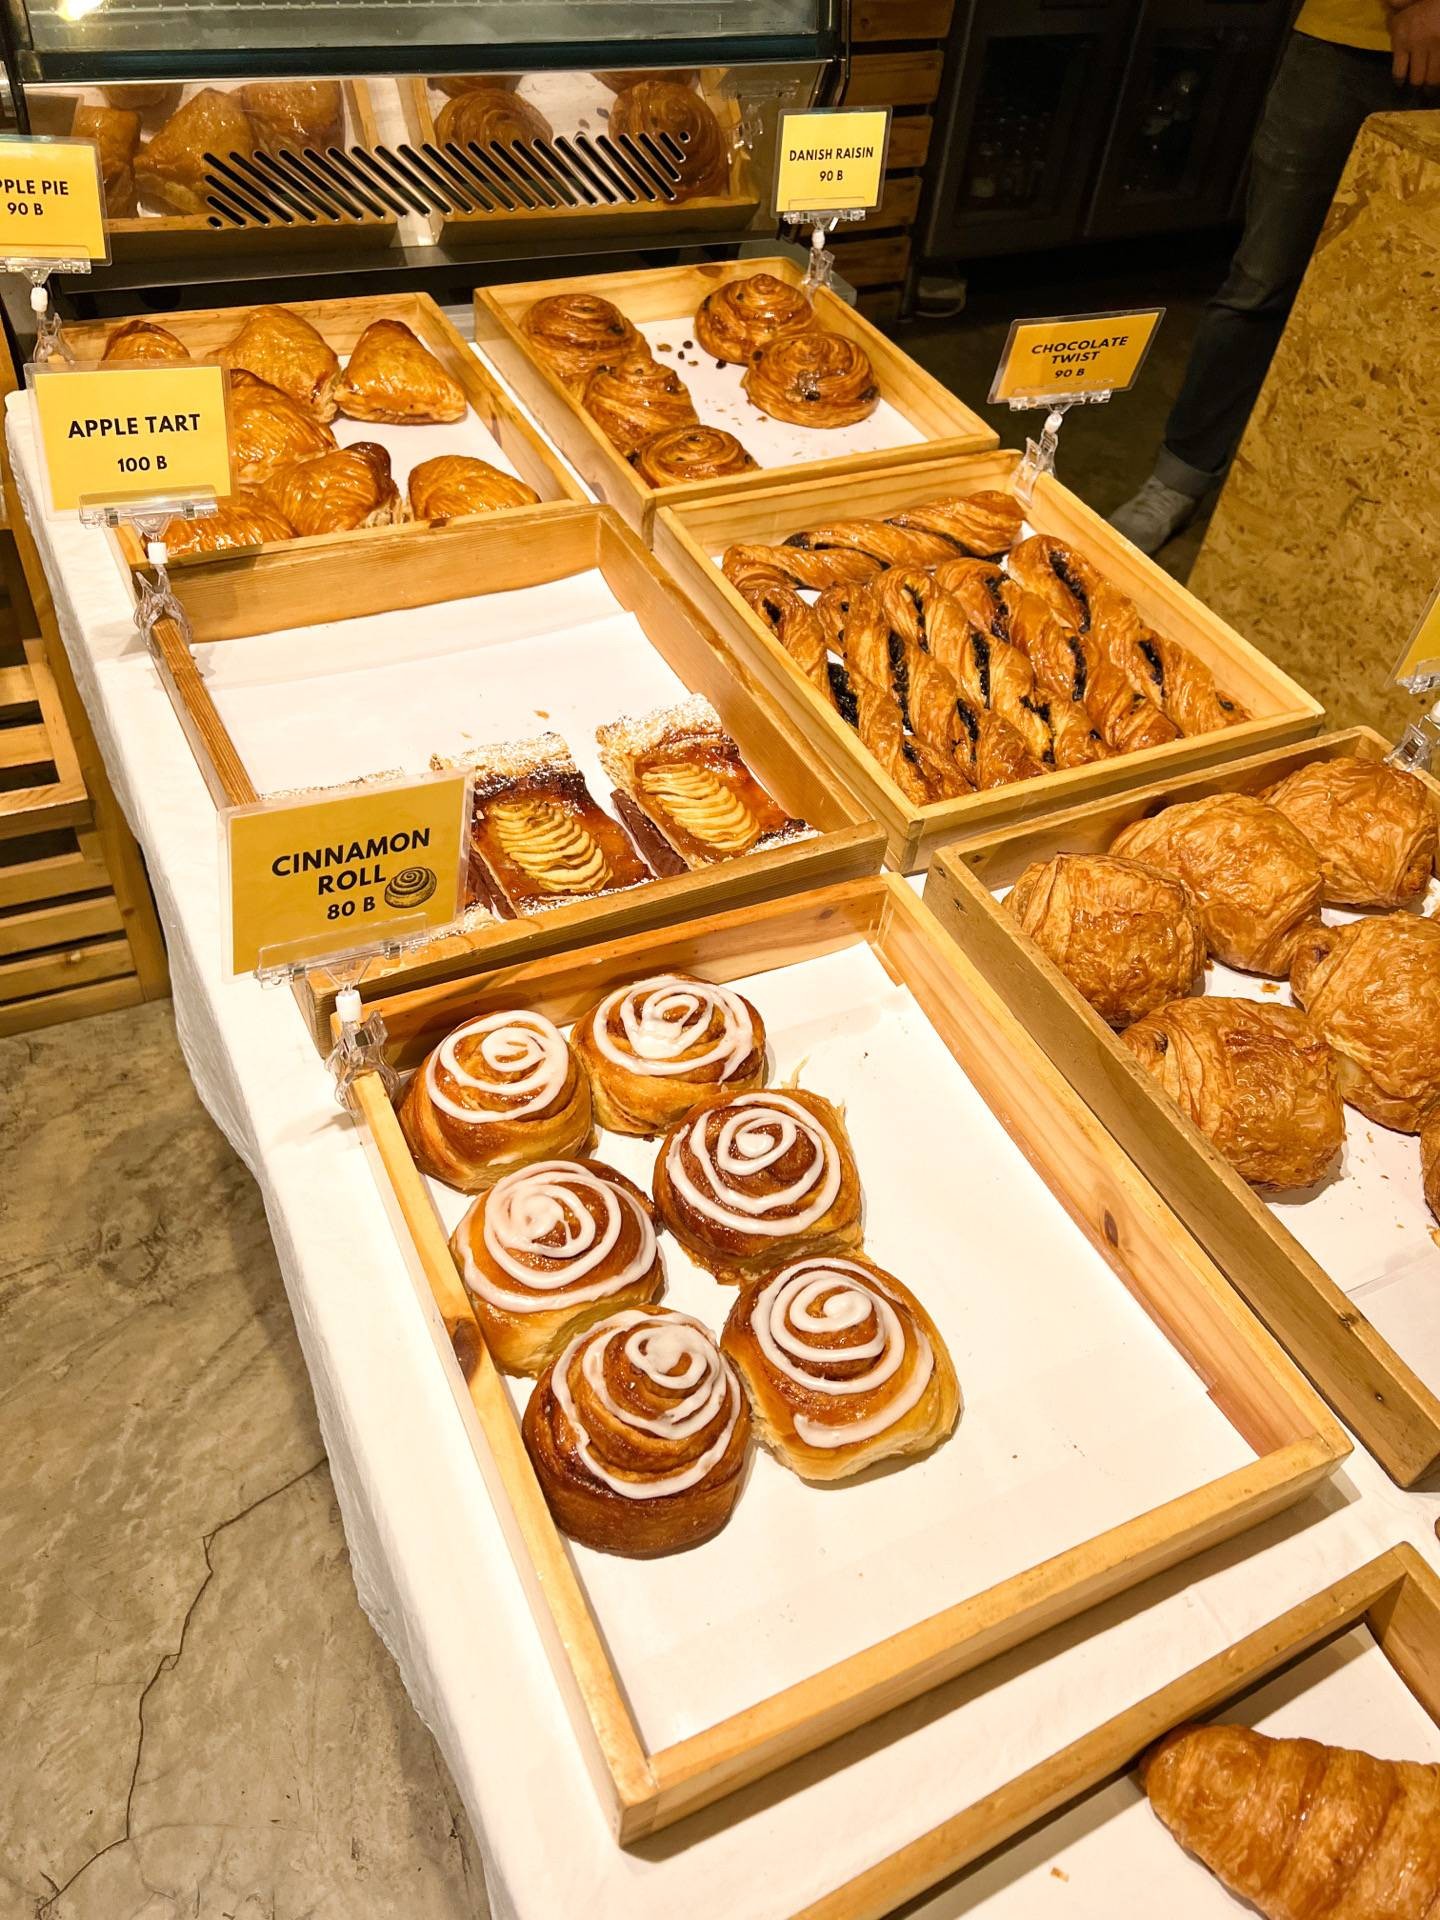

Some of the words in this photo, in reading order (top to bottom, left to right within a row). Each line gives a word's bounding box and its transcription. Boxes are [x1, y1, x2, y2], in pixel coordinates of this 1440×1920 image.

[789, 148, 833, 161] DANISH
[836, 146, 874, 159] RAISIN
[819, 170, 833, 182] 90
[837, 170, 843, 181] B
[0, 179, 36, 195] PLE
[41, 180, 69, 196] PIE
[7, 202, 29, 216] 90
[34, 203, 44, 216] B
[1031, 336, 1130, 355] CHOCOLATE
[1051, 351, 1101, 365] TWIST
[1055, 368, 1073, 379] 90
[1076, 368, 1086, 378] B
[68, 417, 138, 439] APPLE
[144, 413, 201, 434] TART
[117, 457, 151, 473] 100
[156, 455, 169, 470] B
[271, 827, 431, 877] CINNAMON
[317, 864, 387, 896] ROLL
[326, 900, 356, 920] 80
[363, 896, 376, 913] B
